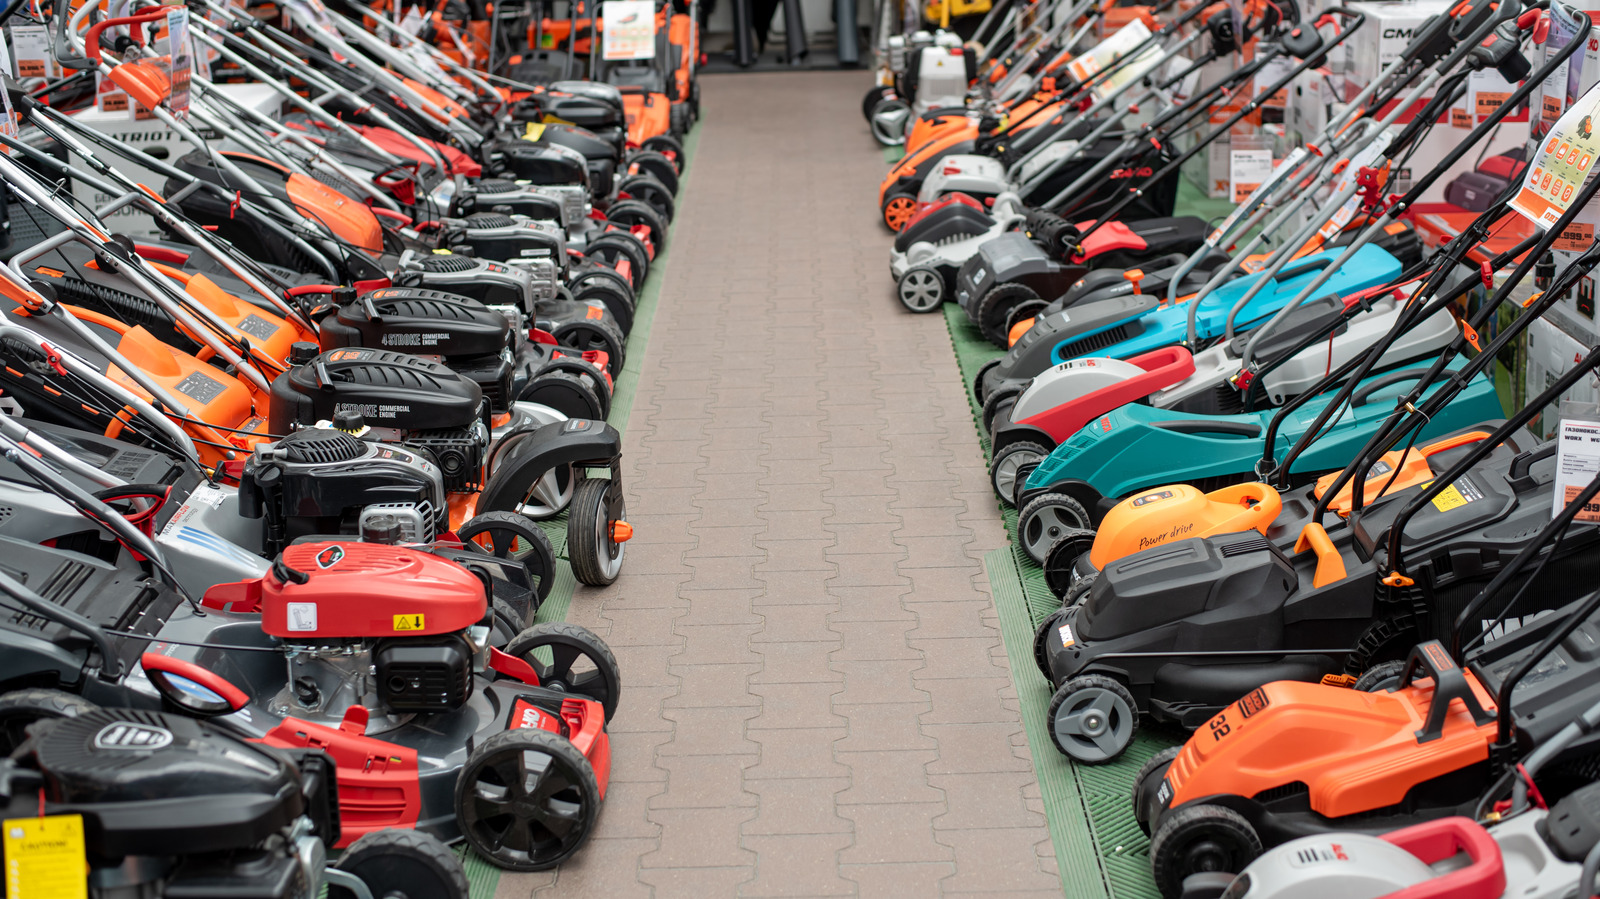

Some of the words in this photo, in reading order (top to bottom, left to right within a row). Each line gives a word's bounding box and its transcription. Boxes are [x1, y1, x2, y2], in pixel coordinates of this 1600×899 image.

[1139, 532, 1169, 550] Power
[1170, 523, 1194, 538] drive
[1210, 715, 1231, 741] 32
